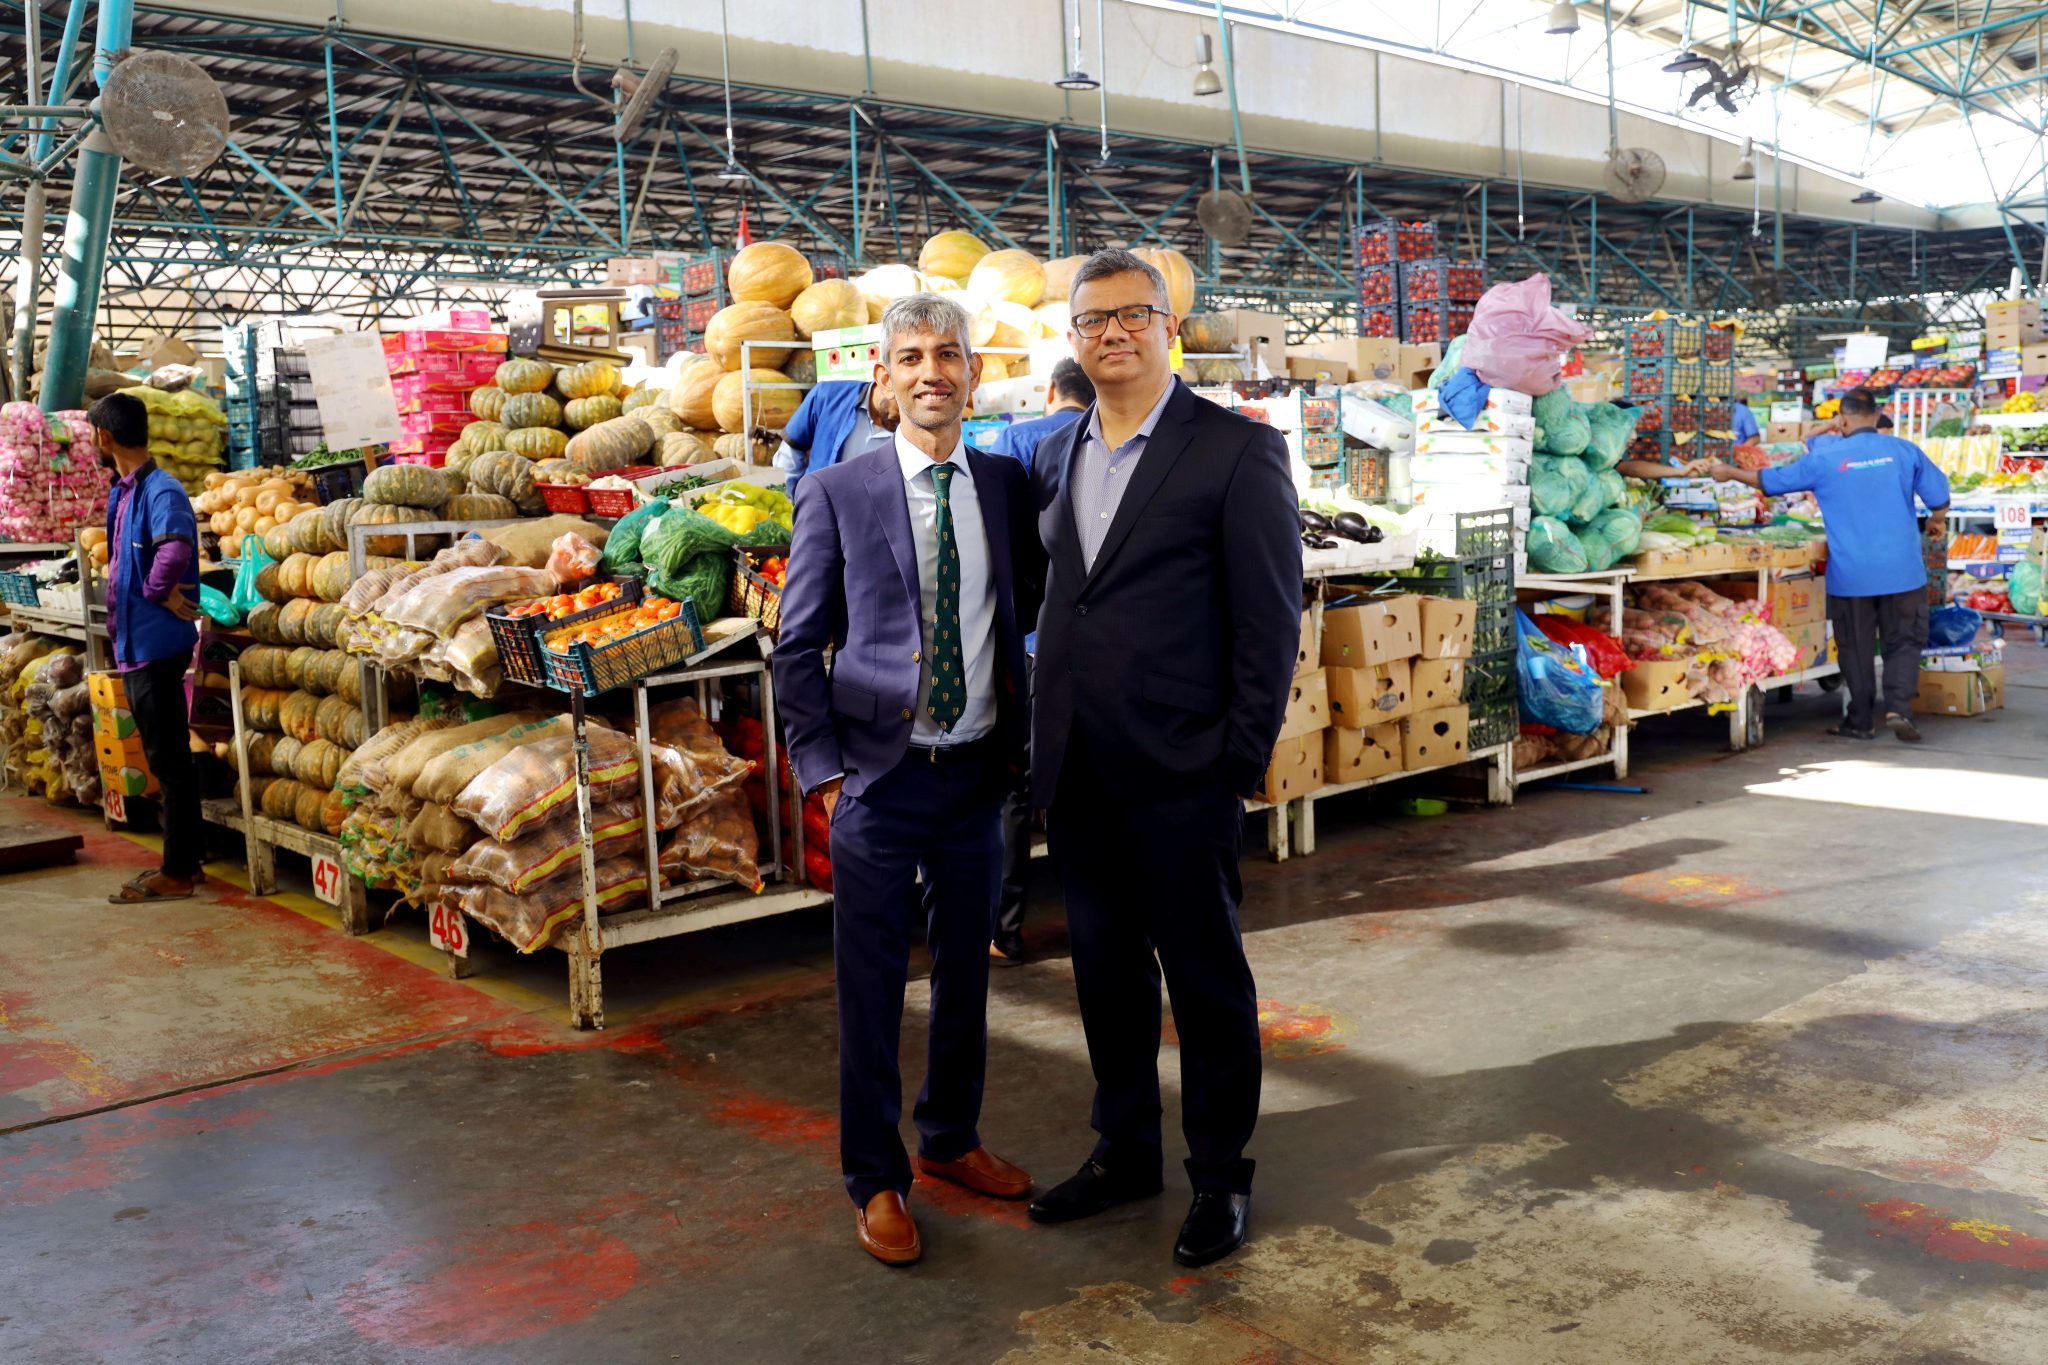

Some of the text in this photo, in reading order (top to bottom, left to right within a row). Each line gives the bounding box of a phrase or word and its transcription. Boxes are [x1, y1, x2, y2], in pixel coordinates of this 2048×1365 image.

[2000, 507, 2026, 523] 108
[106, 790, 123, 818] 48
[315, 858, 339, 900] 47
[432, 904, 463, 950] 46
